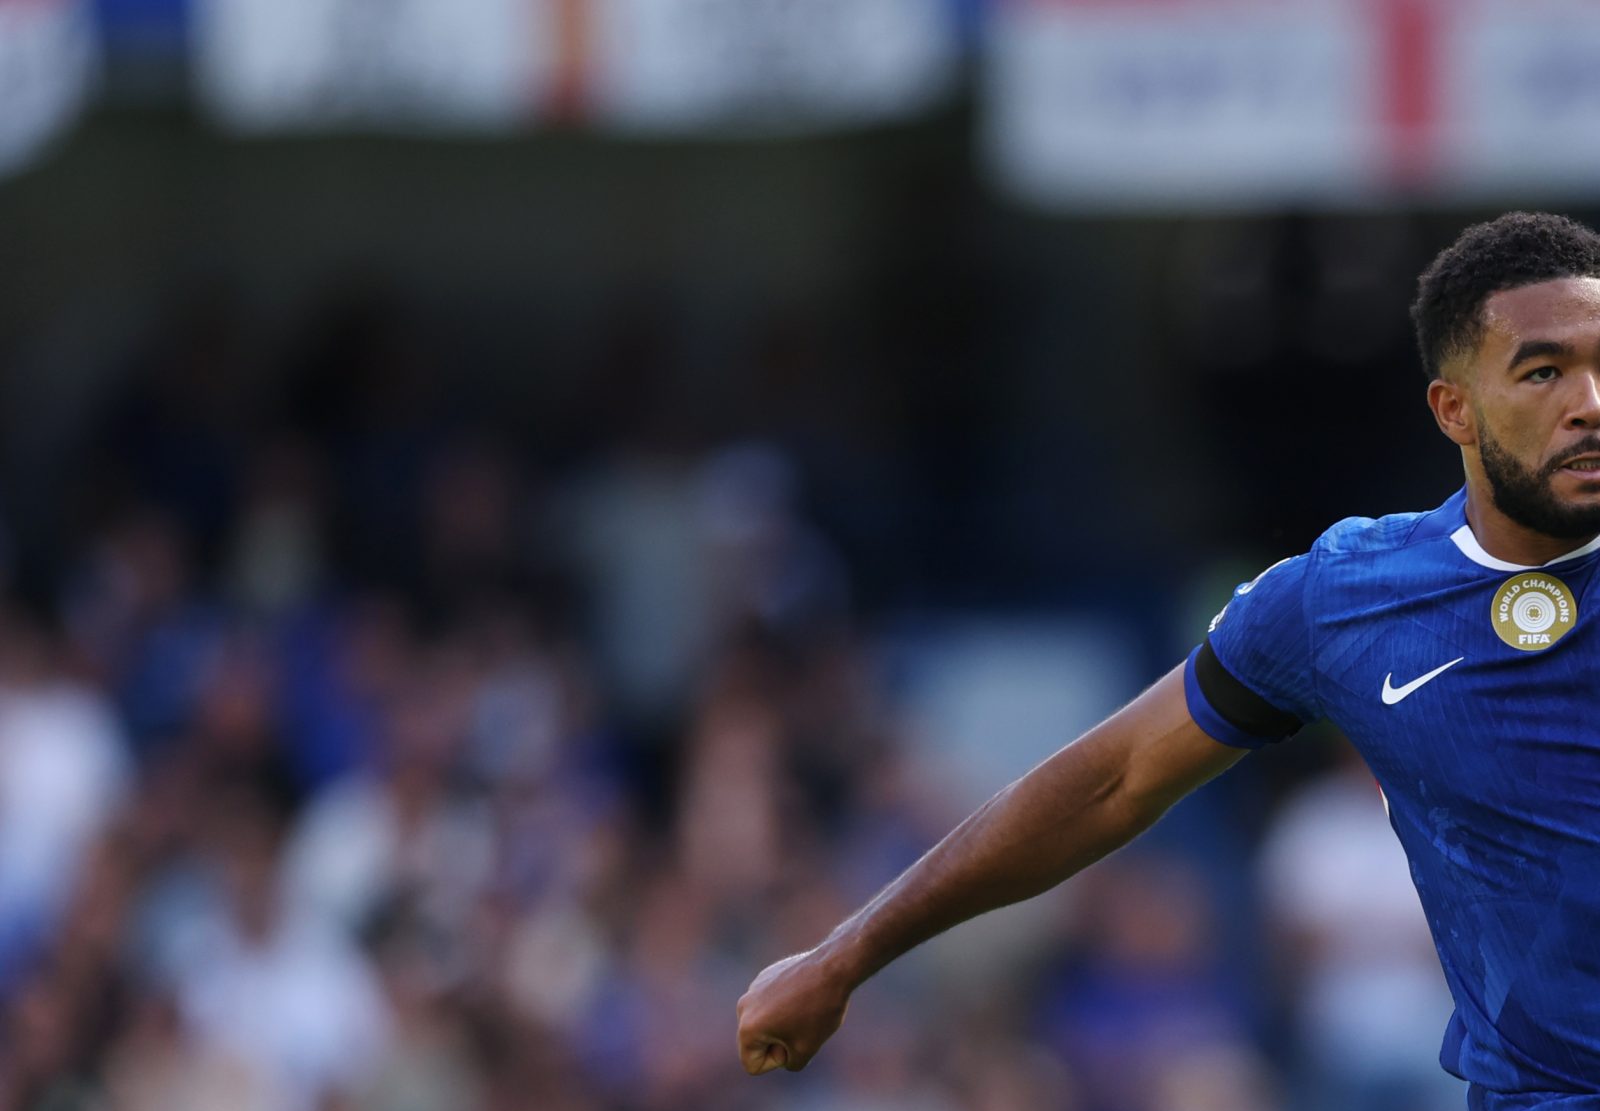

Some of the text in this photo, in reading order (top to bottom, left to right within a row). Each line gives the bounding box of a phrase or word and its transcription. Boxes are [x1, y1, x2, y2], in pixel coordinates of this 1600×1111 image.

[1499, 579, 1569, 623] WORLD CHAMPIONS
[1518, 634, 1550, 645] FIFA
